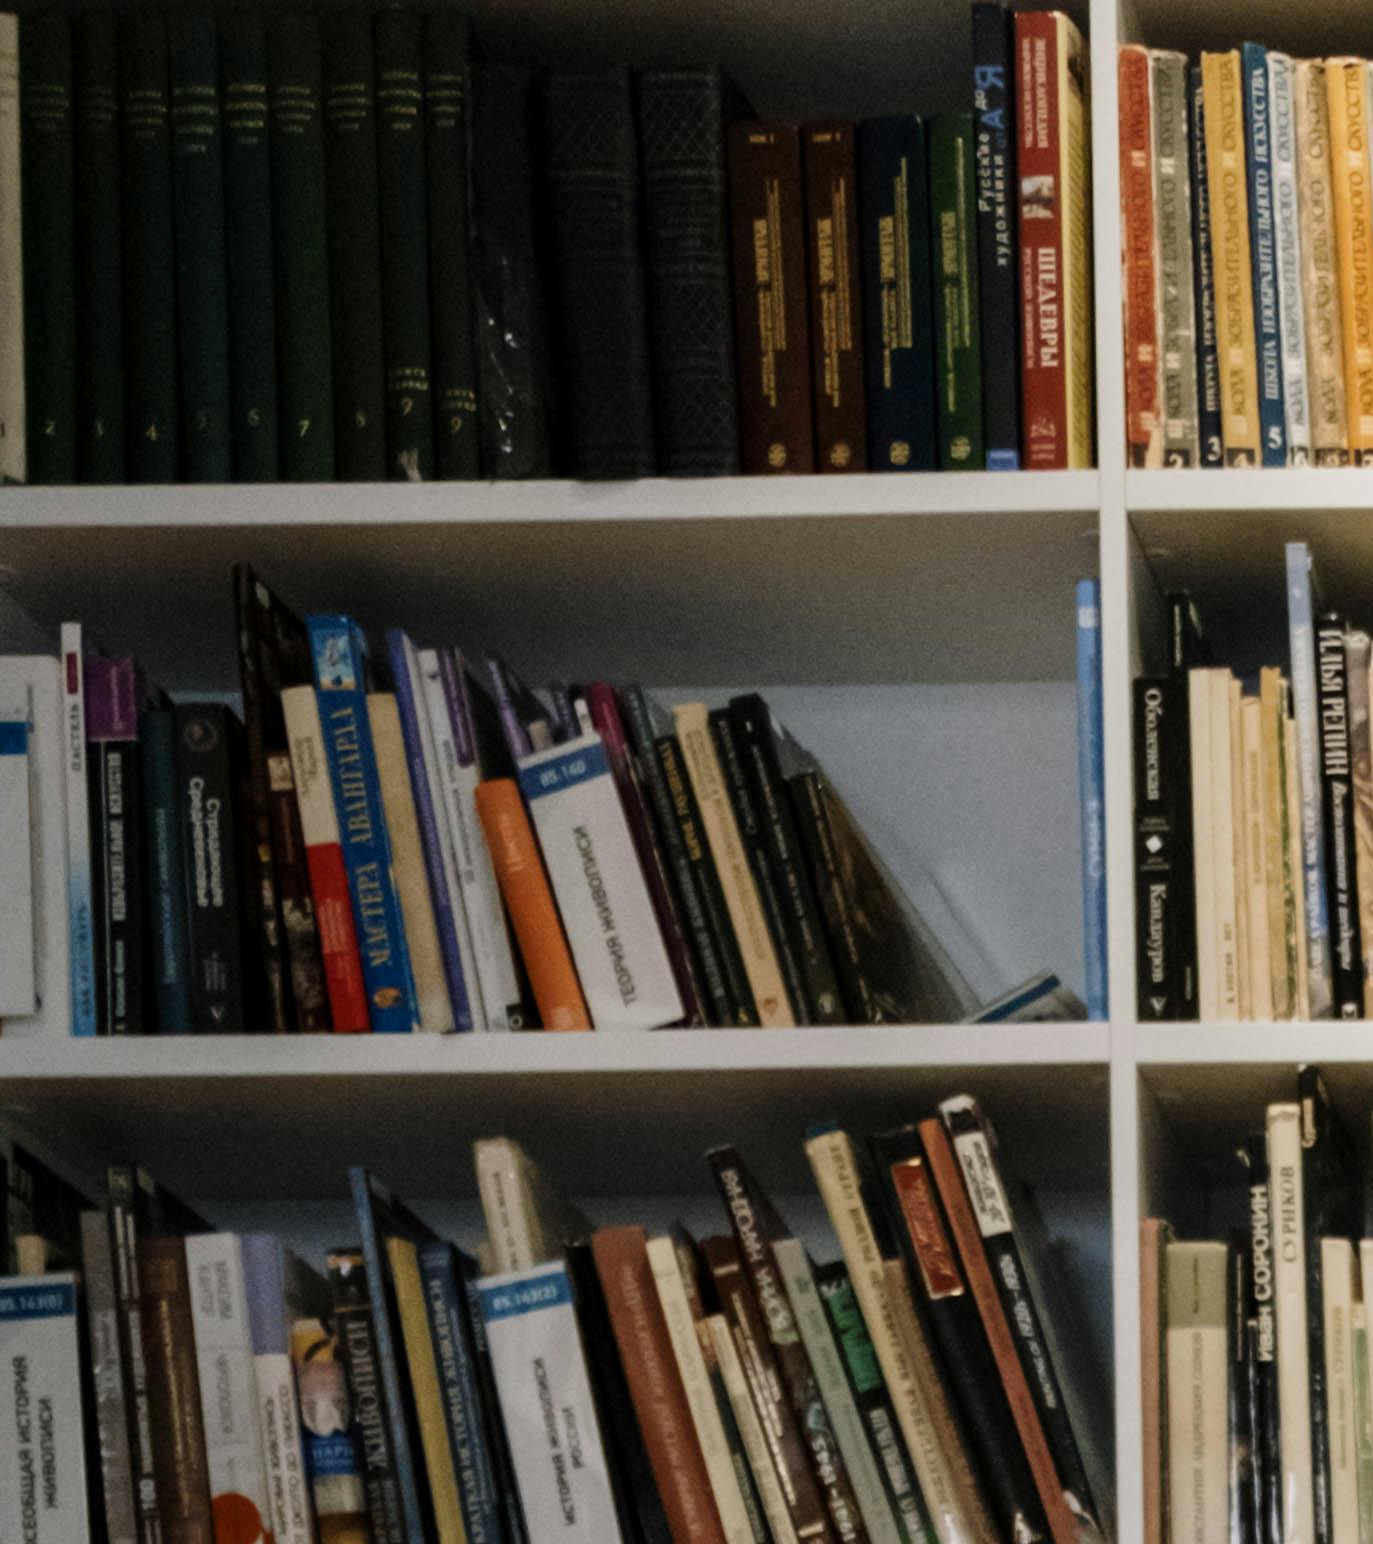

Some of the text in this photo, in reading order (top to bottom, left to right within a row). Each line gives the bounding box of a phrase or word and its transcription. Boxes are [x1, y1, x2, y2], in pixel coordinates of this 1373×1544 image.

[1038, 247, 1059, 366] ШЕДЕВРЫ
[1318, 628, 1348, 776] ИЛЬЯ РЕПИН
[330, 707, 393, 968] МАСТЕРА АВАНГАРДА
[572, 826, 640, 1008] ТЕОРИЯ ЖИВОПИСИ
[719, 1167, 770, 1264] НАРОДНАЯ
[1249, 1184, 1276, 1361] Иван СОРОКИН
[1279, 1164, 1297, 1264] СУРИКОВ
[12, 1356, 33, 1445] ИСТОРИЯ
[38, 1398, 58, 1510] ЖИВОПИСИ
[348, 1319, 390, 1472] ЖИВОПИСИ
[427, 1276, 487, 1544] КРАТКАЯ ИСТОРИЯ ЖИВОПИСИ
[532, 1357, 577, 1527] ИСТОРИЯ ЖИВОПИСИ
[561, 1404, 584, 1469] РОССИИ
